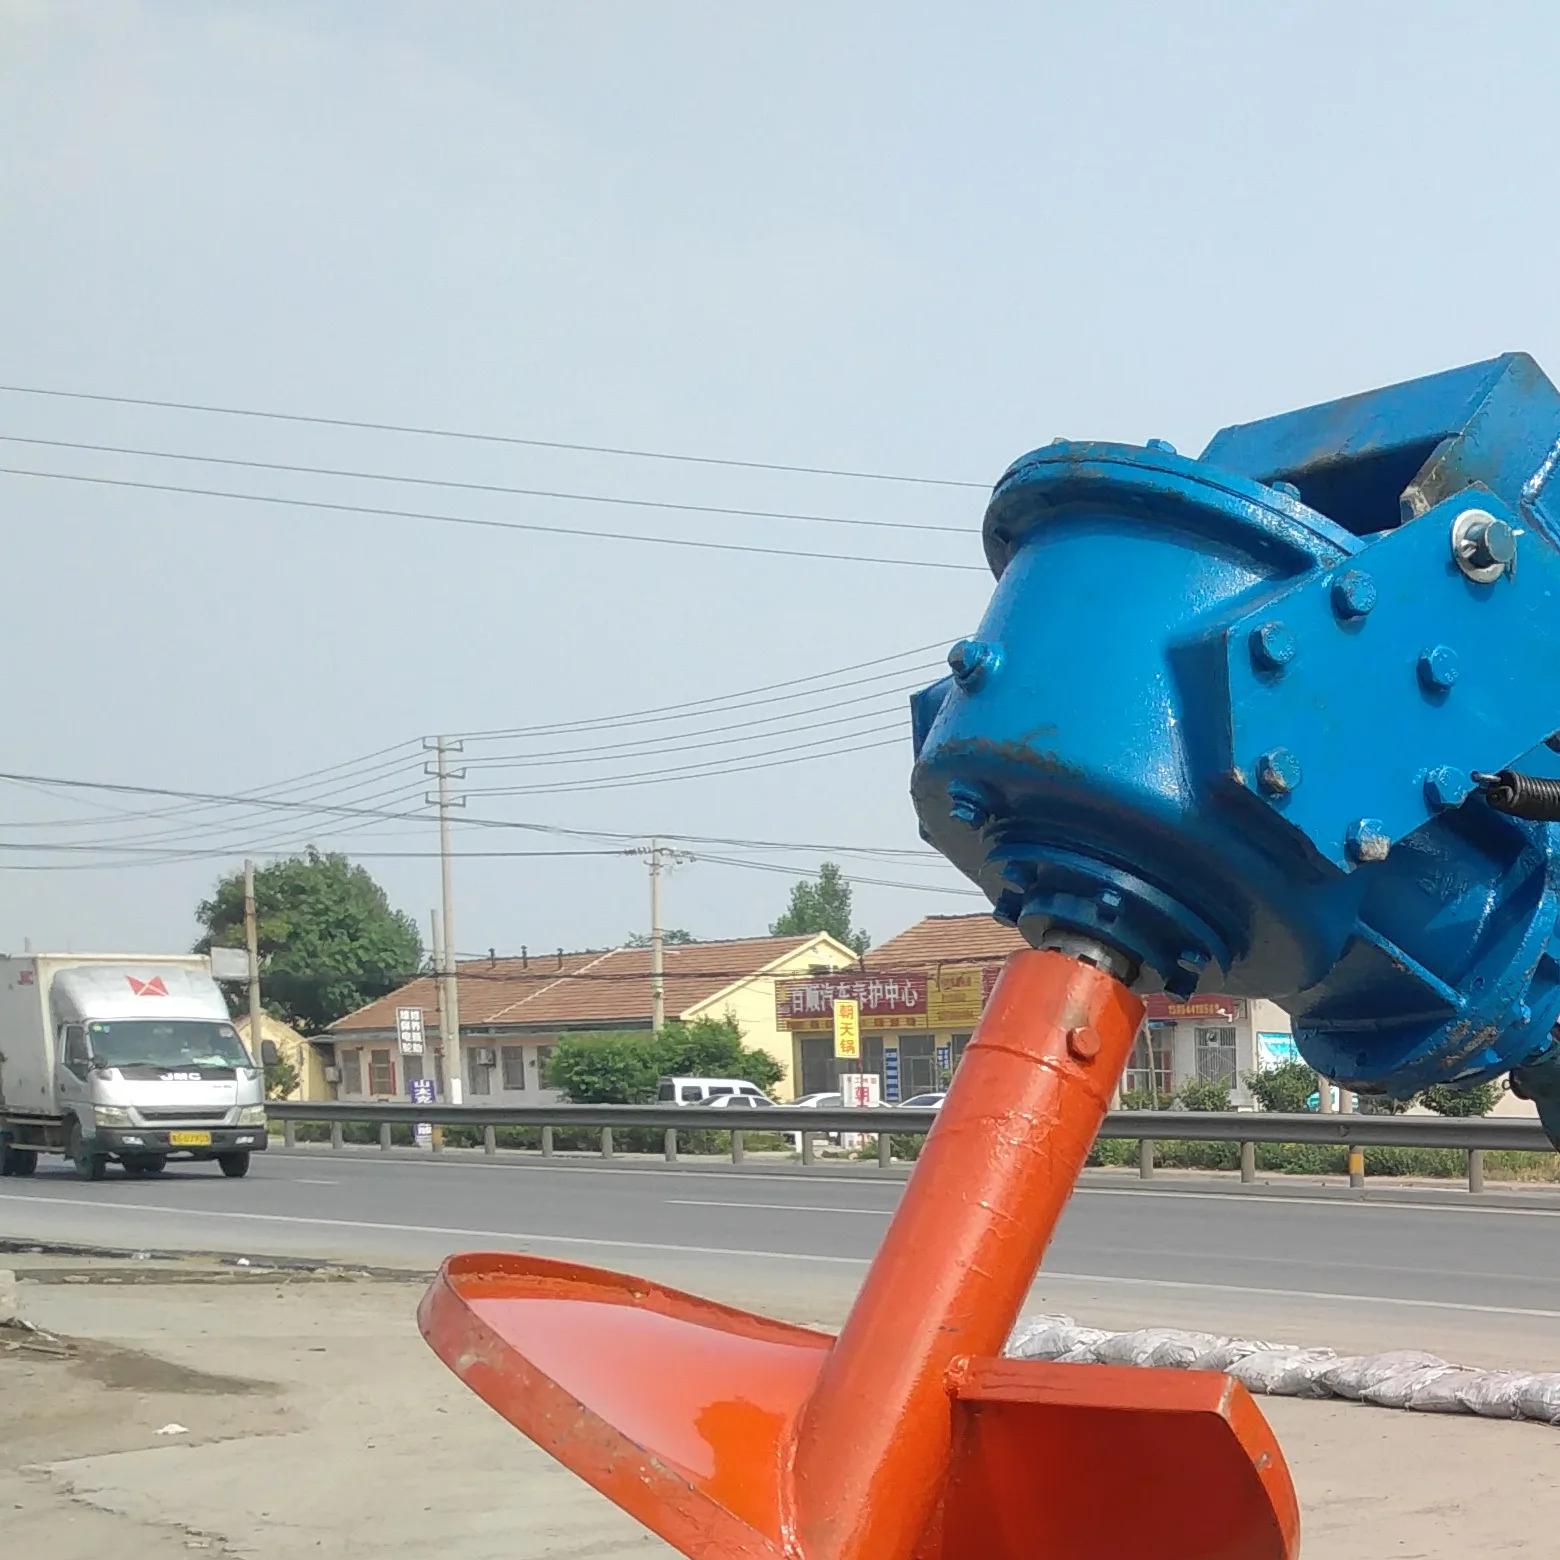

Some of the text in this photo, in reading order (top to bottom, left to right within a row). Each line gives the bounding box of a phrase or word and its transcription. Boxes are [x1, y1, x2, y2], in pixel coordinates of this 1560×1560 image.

[838, 1004, 856, 1055] 朝天锅
[158, 1072, 201, 1081] JMC
